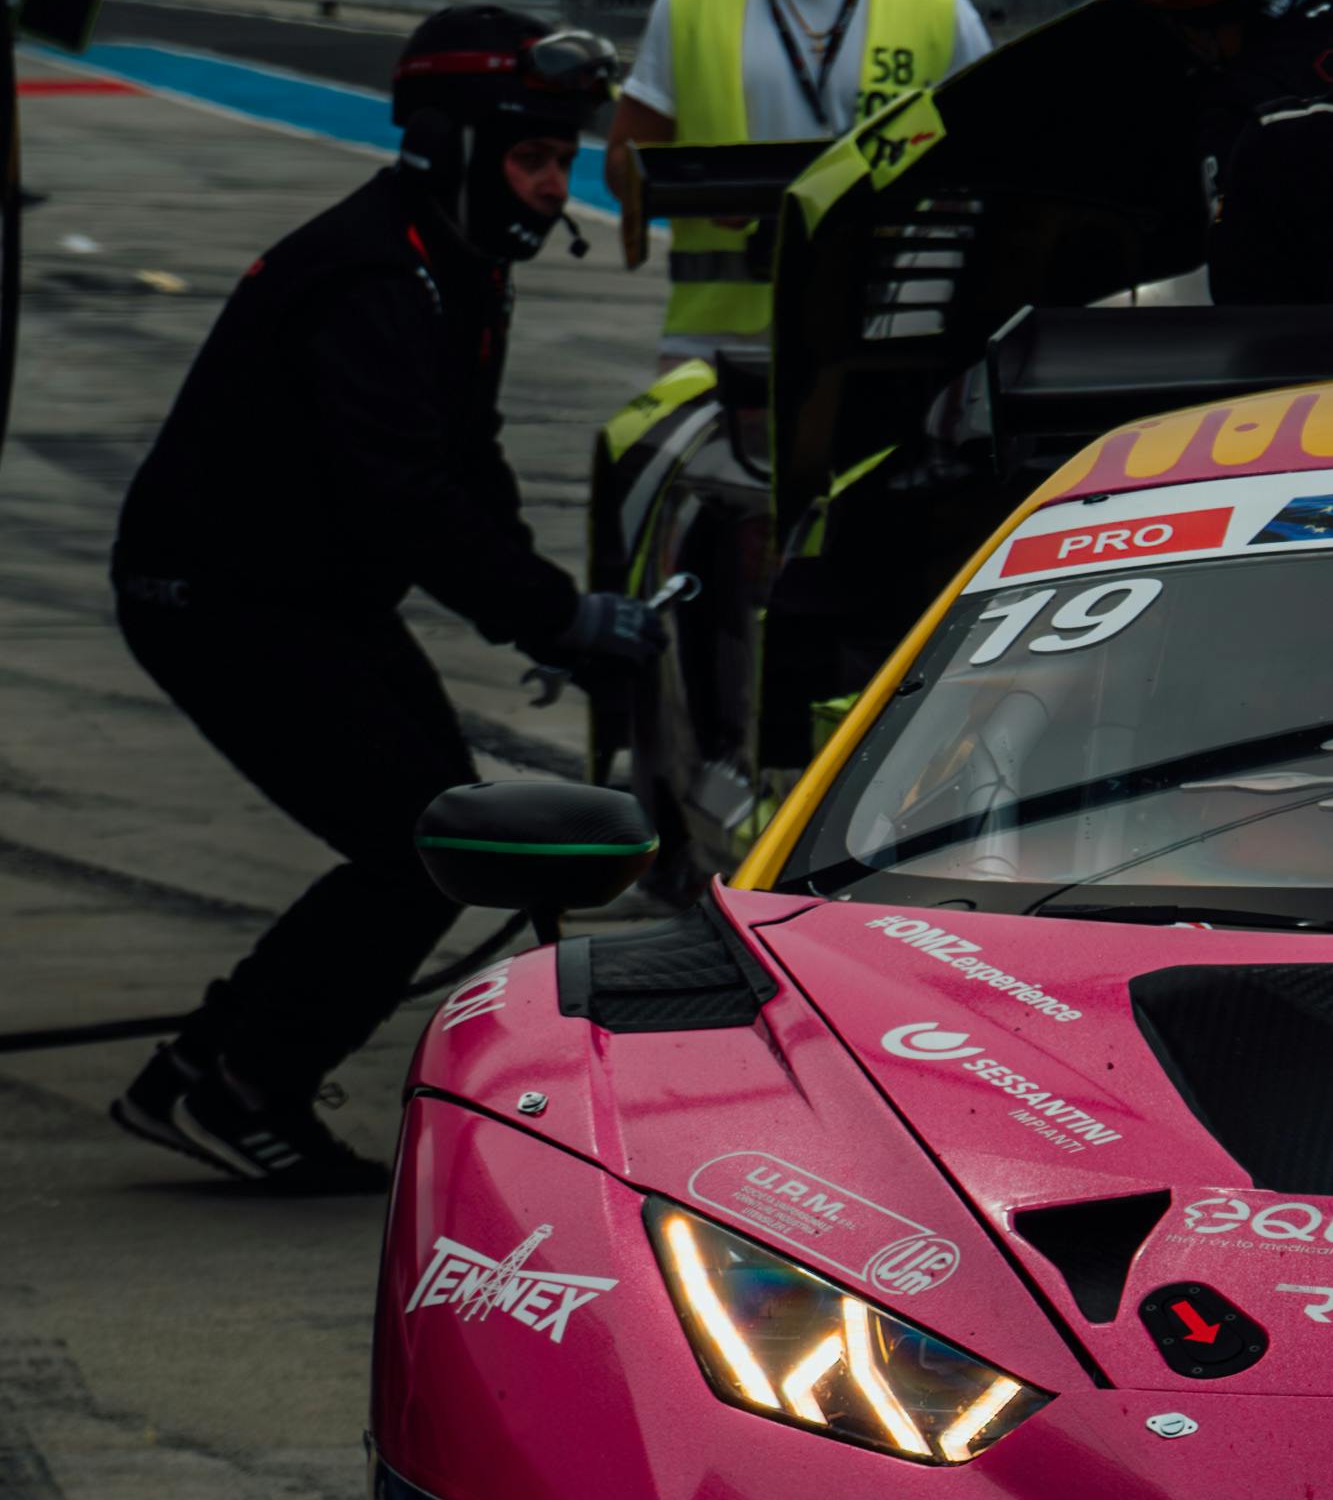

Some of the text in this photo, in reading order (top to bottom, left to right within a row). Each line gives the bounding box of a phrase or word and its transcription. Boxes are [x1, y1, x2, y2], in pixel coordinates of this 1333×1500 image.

[872, 48, 914, 86] 58
[1057, 523, 1174, 560] PRO
[969, 578, 1163, 666] 19
[864, 915, 1083, 1023] #OMZexperience
[962, 1058, 1123, 1146] SESSANTINI
[1008, 1110, 1086, 1154] IMPIANTI
